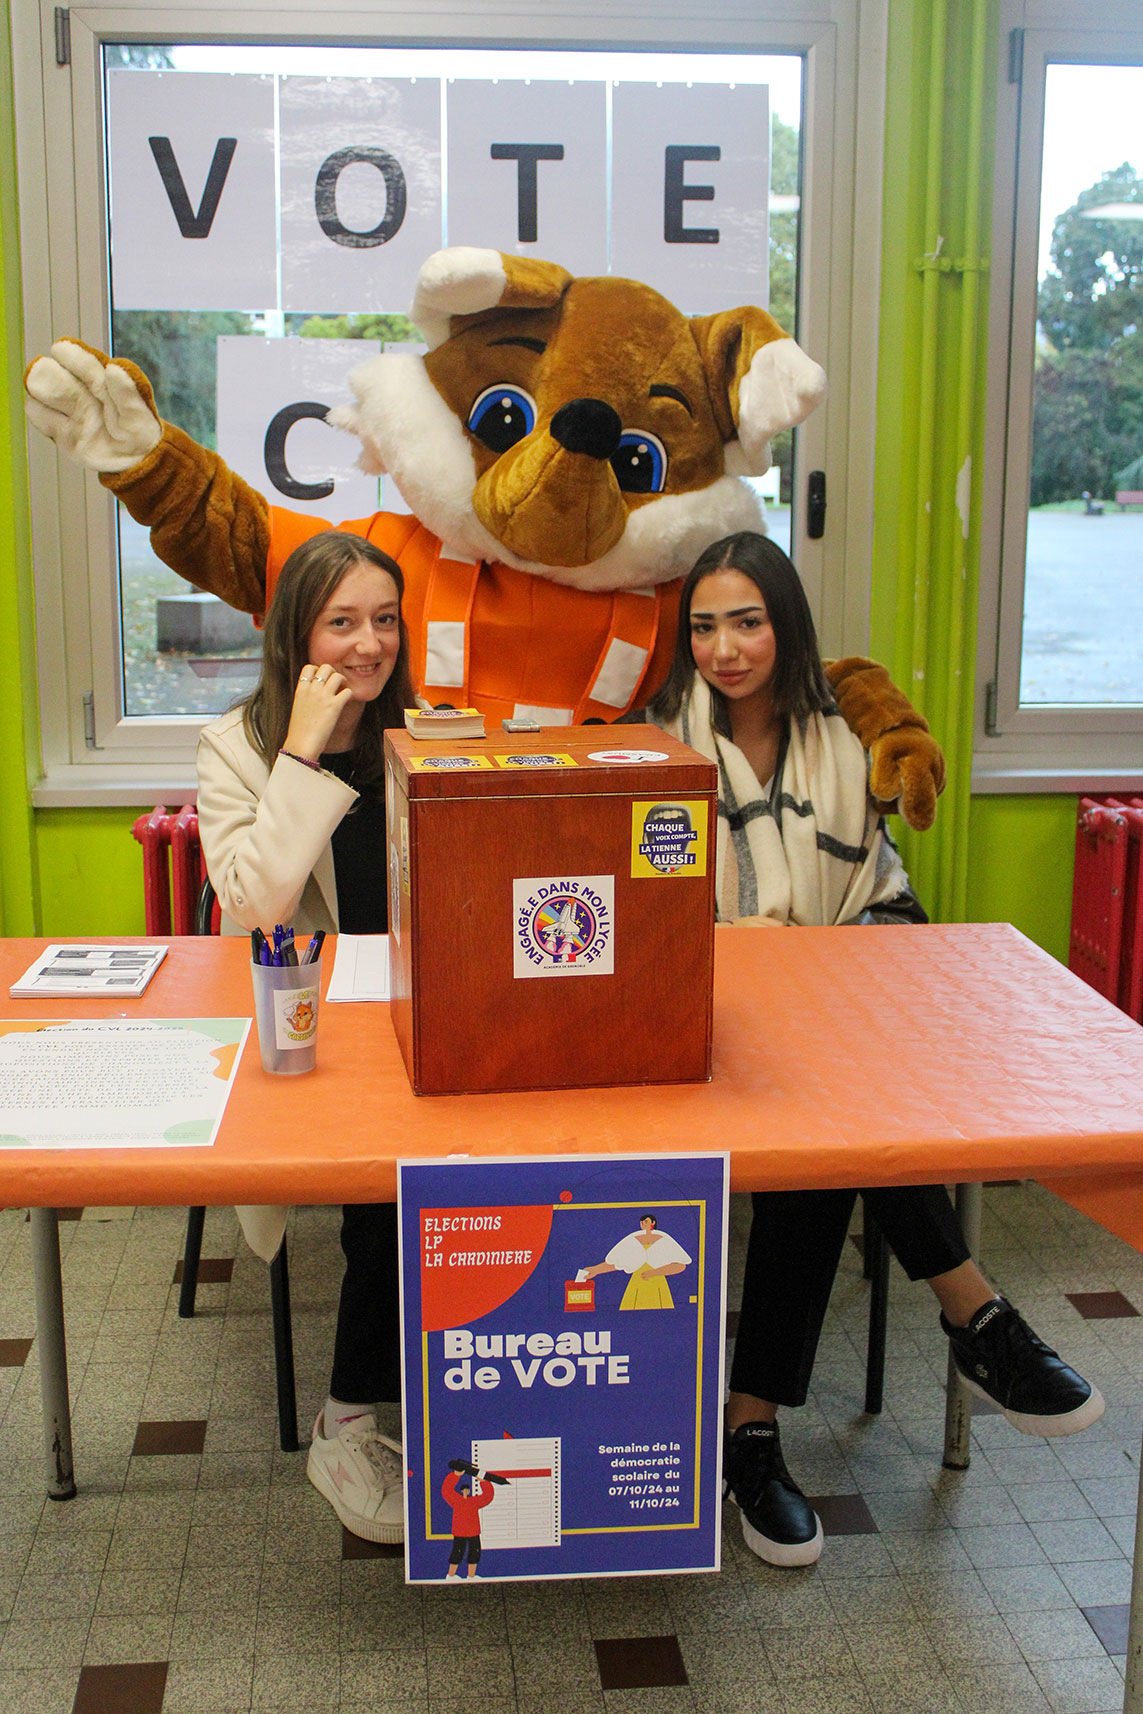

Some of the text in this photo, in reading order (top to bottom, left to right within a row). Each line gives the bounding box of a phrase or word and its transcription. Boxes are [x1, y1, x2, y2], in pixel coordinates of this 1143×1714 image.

[148, 136, 722, 249] VOTE
[645, 824, 684, 833] CHAQUE
[652, 844, 682, 852] TIENNE
[537, 881, 580, 899] DANS
[581, 886, 609, 918] MON
[584, 921, 610, 963] LYCÉE
[424, 1216, 502, 1232] ELECTIONS
[425, 1235, 443, 1250] LP
[425, 1250, 533, 1267] LA CARDINIERE
[443, 1330, 611, 1359] Bureau
[443, 1355, 630, 1391] de VOTE
[598, 1441, 680, 1454] Semaine de la
[610, 1455, 680, 1468] démocratie
[612, 1470, 680, 1482] scolaire du
[608, 1485, 680, 1496] 07/10/24 au
[629, 1498, 680, 1509] 11/10/24
